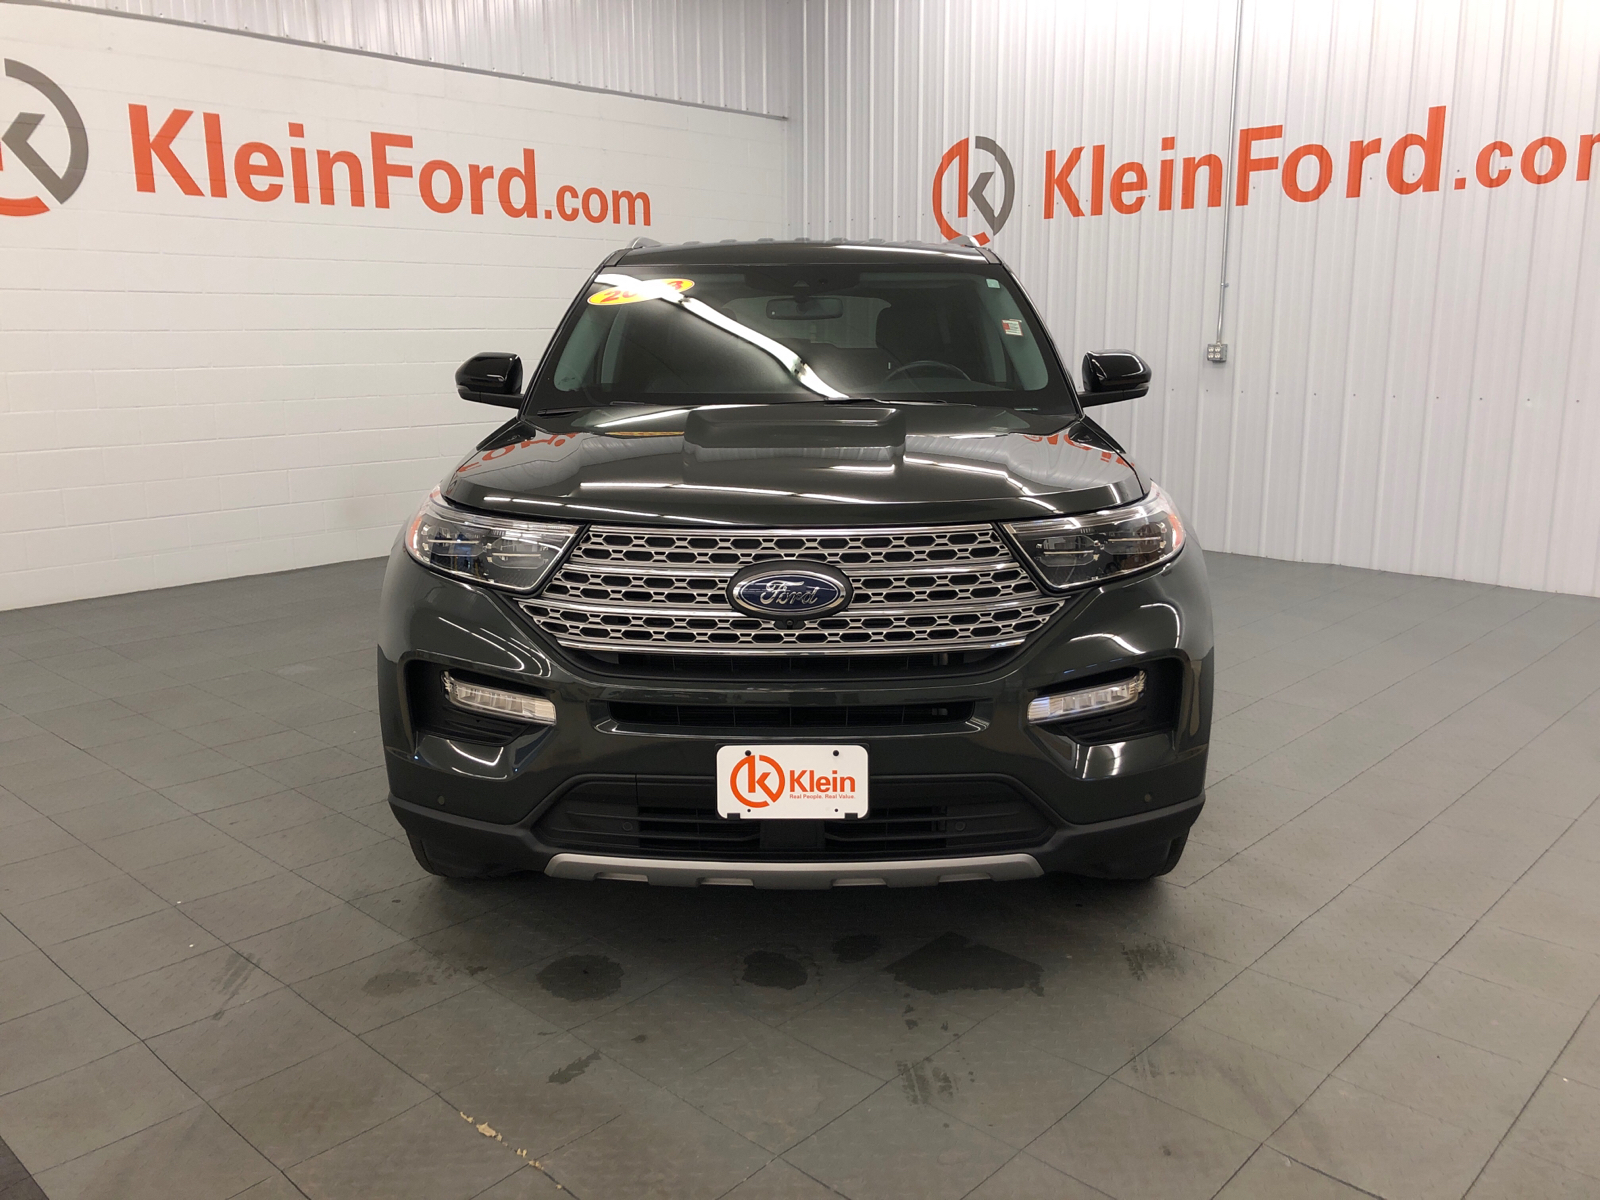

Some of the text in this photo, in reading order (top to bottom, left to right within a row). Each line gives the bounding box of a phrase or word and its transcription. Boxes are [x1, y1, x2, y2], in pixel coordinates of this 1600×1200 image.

[128, 103, 651, 227] KleinFord.com
[600, 280, 684, 303] 23
[759, 579, 820, 605] Ford
[789, 770, 856, 793] Klein
